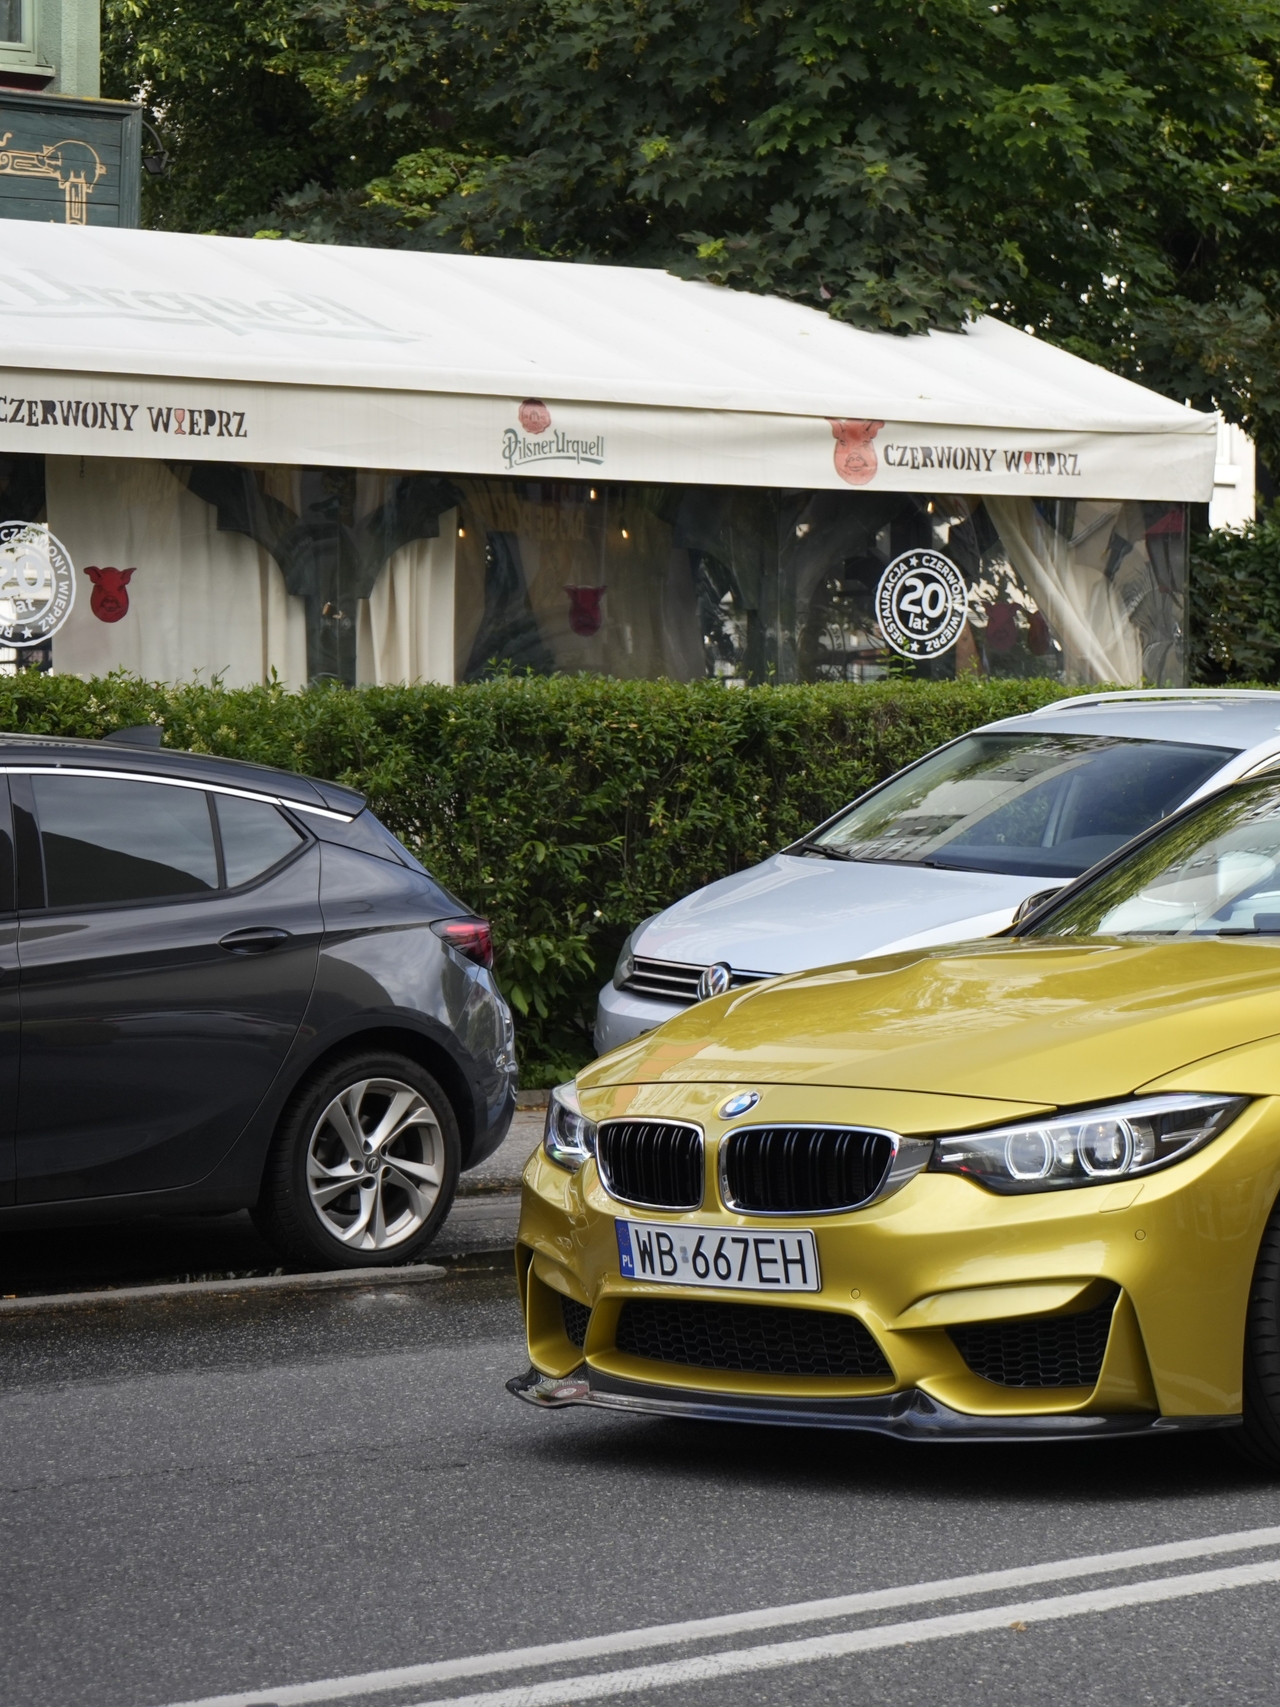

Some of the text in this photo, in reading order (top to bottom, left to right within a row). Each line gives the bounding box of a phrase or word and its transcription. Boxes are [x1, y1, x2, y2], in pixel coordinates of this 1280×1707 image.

[502, 428, 604, 470] Pilsner Urquell
[884, 443, 997, 472] CZERWONY
[38, 580, 70, 632] WIEPRZ
[881, 562, 908, 645] RESTAURACJA
[925, 616, 961, 652] WIEPRZ
[900, 577, 946, 618] 20
[908, 613, 929, 631] lat
[622, 1254, 633, 1268] PL
[635, 1228, 808, 1285] WB 667EH
